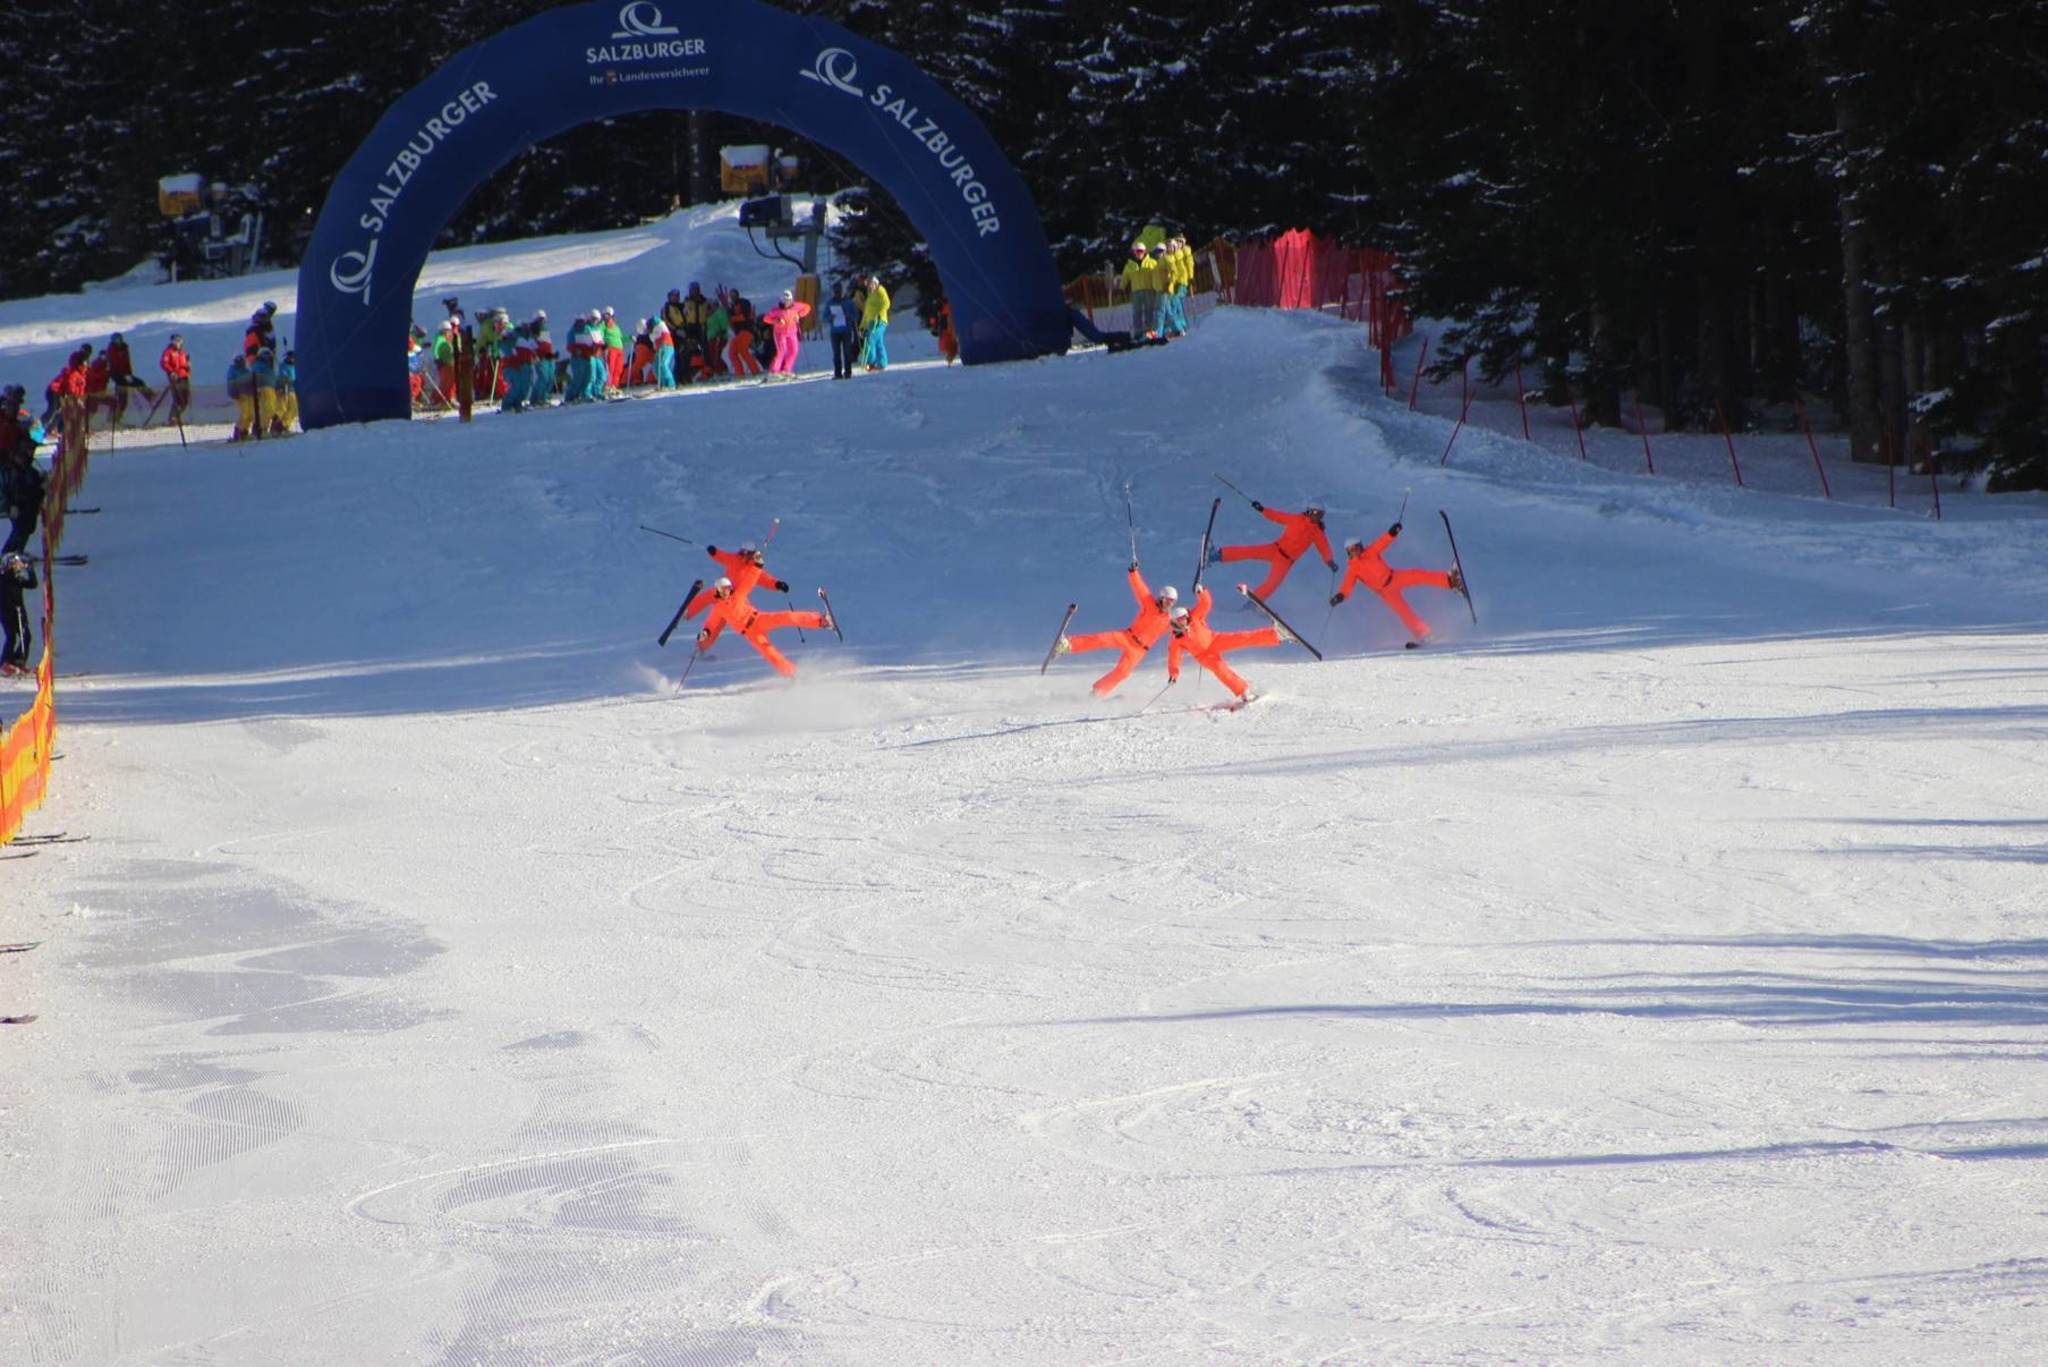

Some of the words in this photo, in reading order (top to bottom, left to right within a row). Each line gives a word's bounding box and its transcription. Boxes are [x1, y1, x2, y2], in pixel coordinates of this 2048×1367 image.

[586, 39, 706, 64] SALZBURGER
[590, 74, 604, 85] Ihr
[619, 67, 710, 82] Landesversicherer
[360, 81, 498, 233] SALZBURGER
[870, 84, 1001, 238] SALZBURGER
